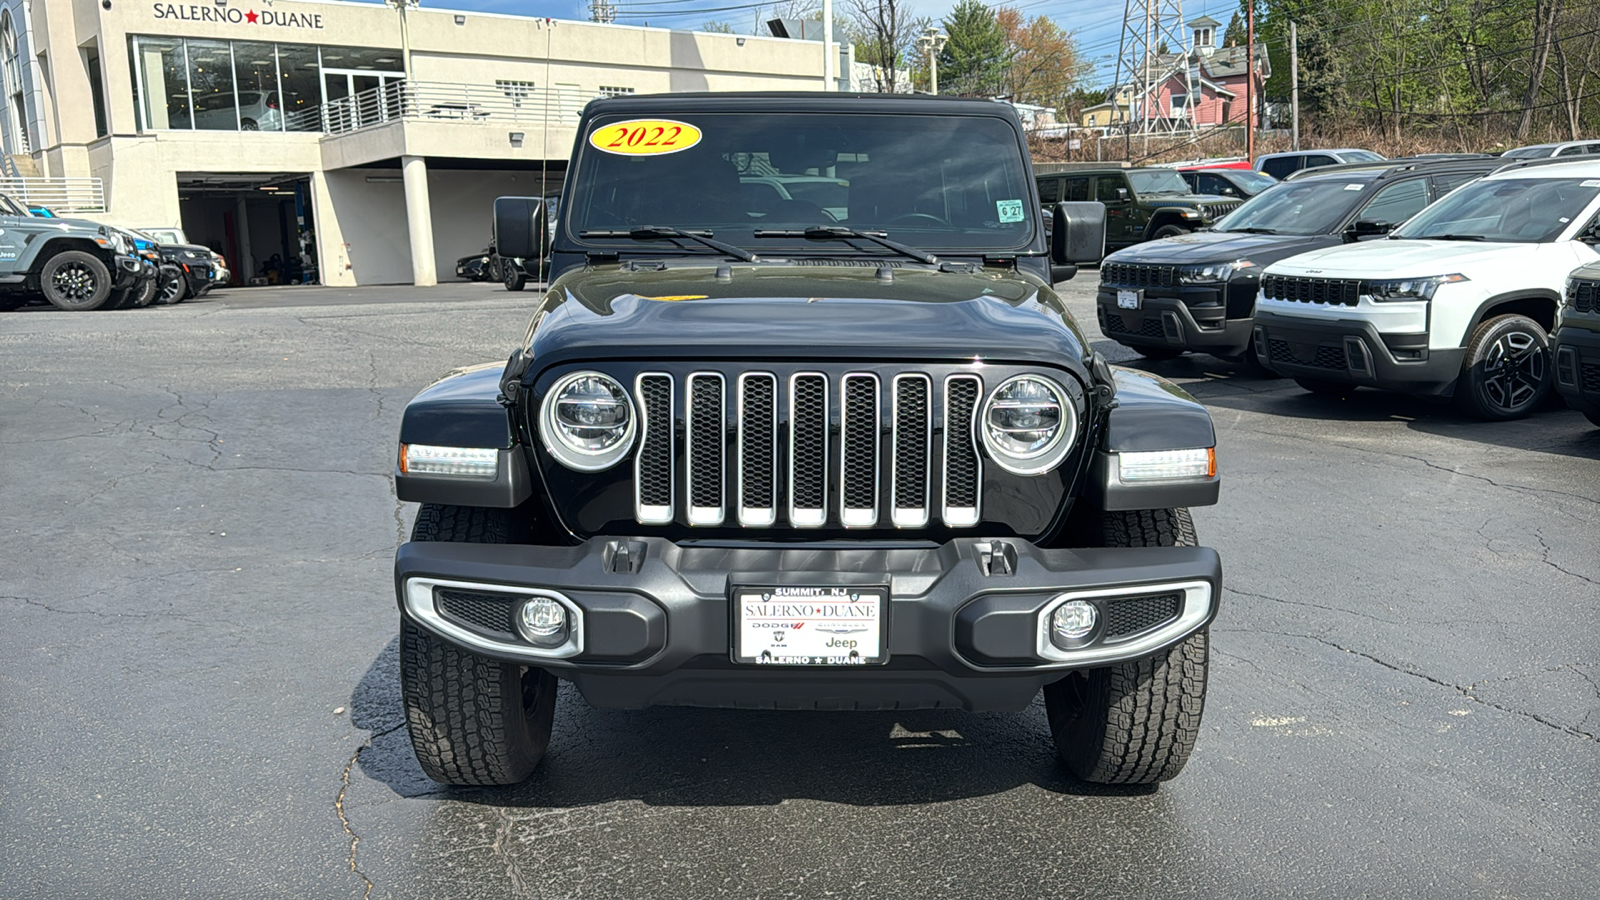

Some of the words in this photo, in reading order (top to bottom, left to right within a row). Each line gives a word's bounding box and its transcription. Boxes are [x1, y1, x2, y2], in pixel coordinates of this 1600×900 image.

[153, 3, 243, 23] SALERNO
[261, 11, 324, 29] DUANE
[607, 127, 681, 147] 2022
[1010, 206, 1021, 216] 27
[775, 588, 825, 596] SUMMIT,
[831, 588, 847, 596] NJ
[746, 605, 814, 617] SALERNO
[823, 605, 875, 617] DUANE
[826, 637, 857, 649] Jeep
